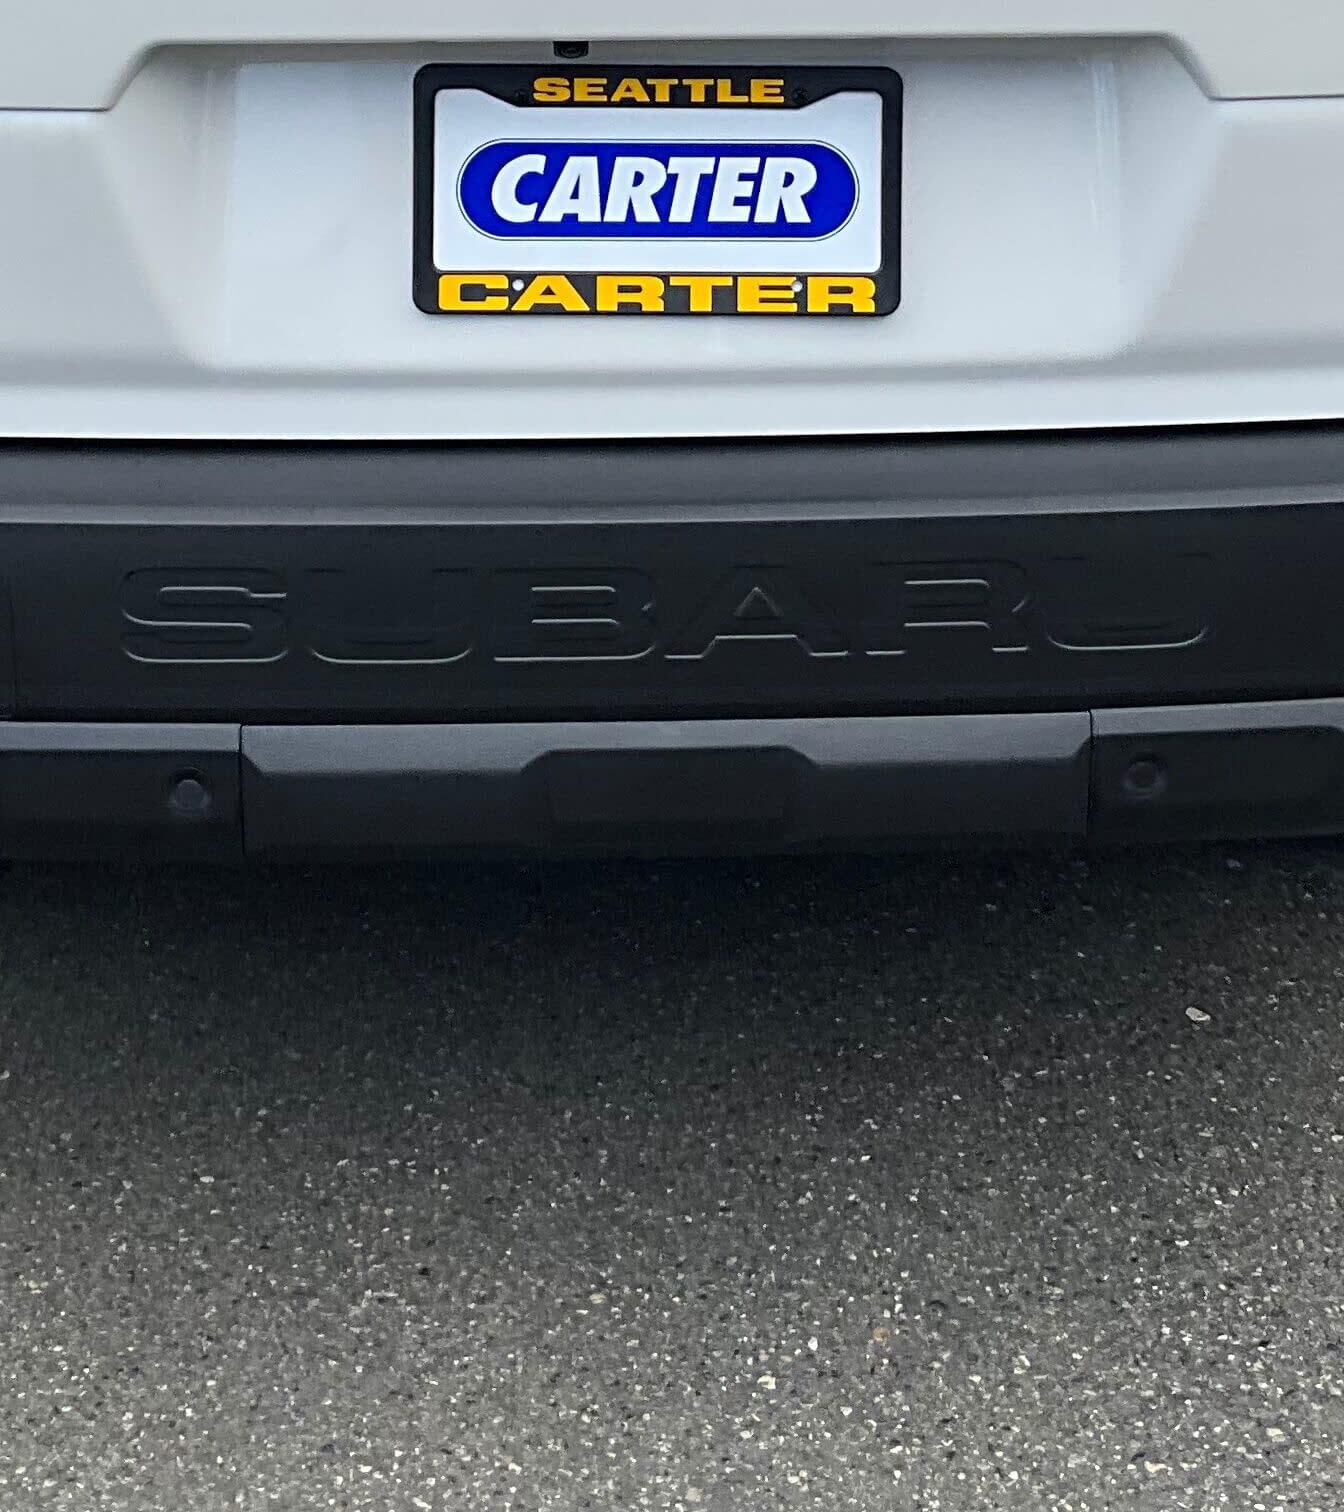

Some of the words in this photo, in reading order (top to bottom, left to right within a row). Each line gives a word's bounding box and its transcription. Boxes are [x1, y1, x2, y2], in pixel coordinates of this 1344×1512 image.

[532, 76, 785, 103] SEATTLE
[490, 153, 817, 223] CARTER
[438, 274, 876, 313] CARTER
[118, 553, 1213, 666] SUBARU
